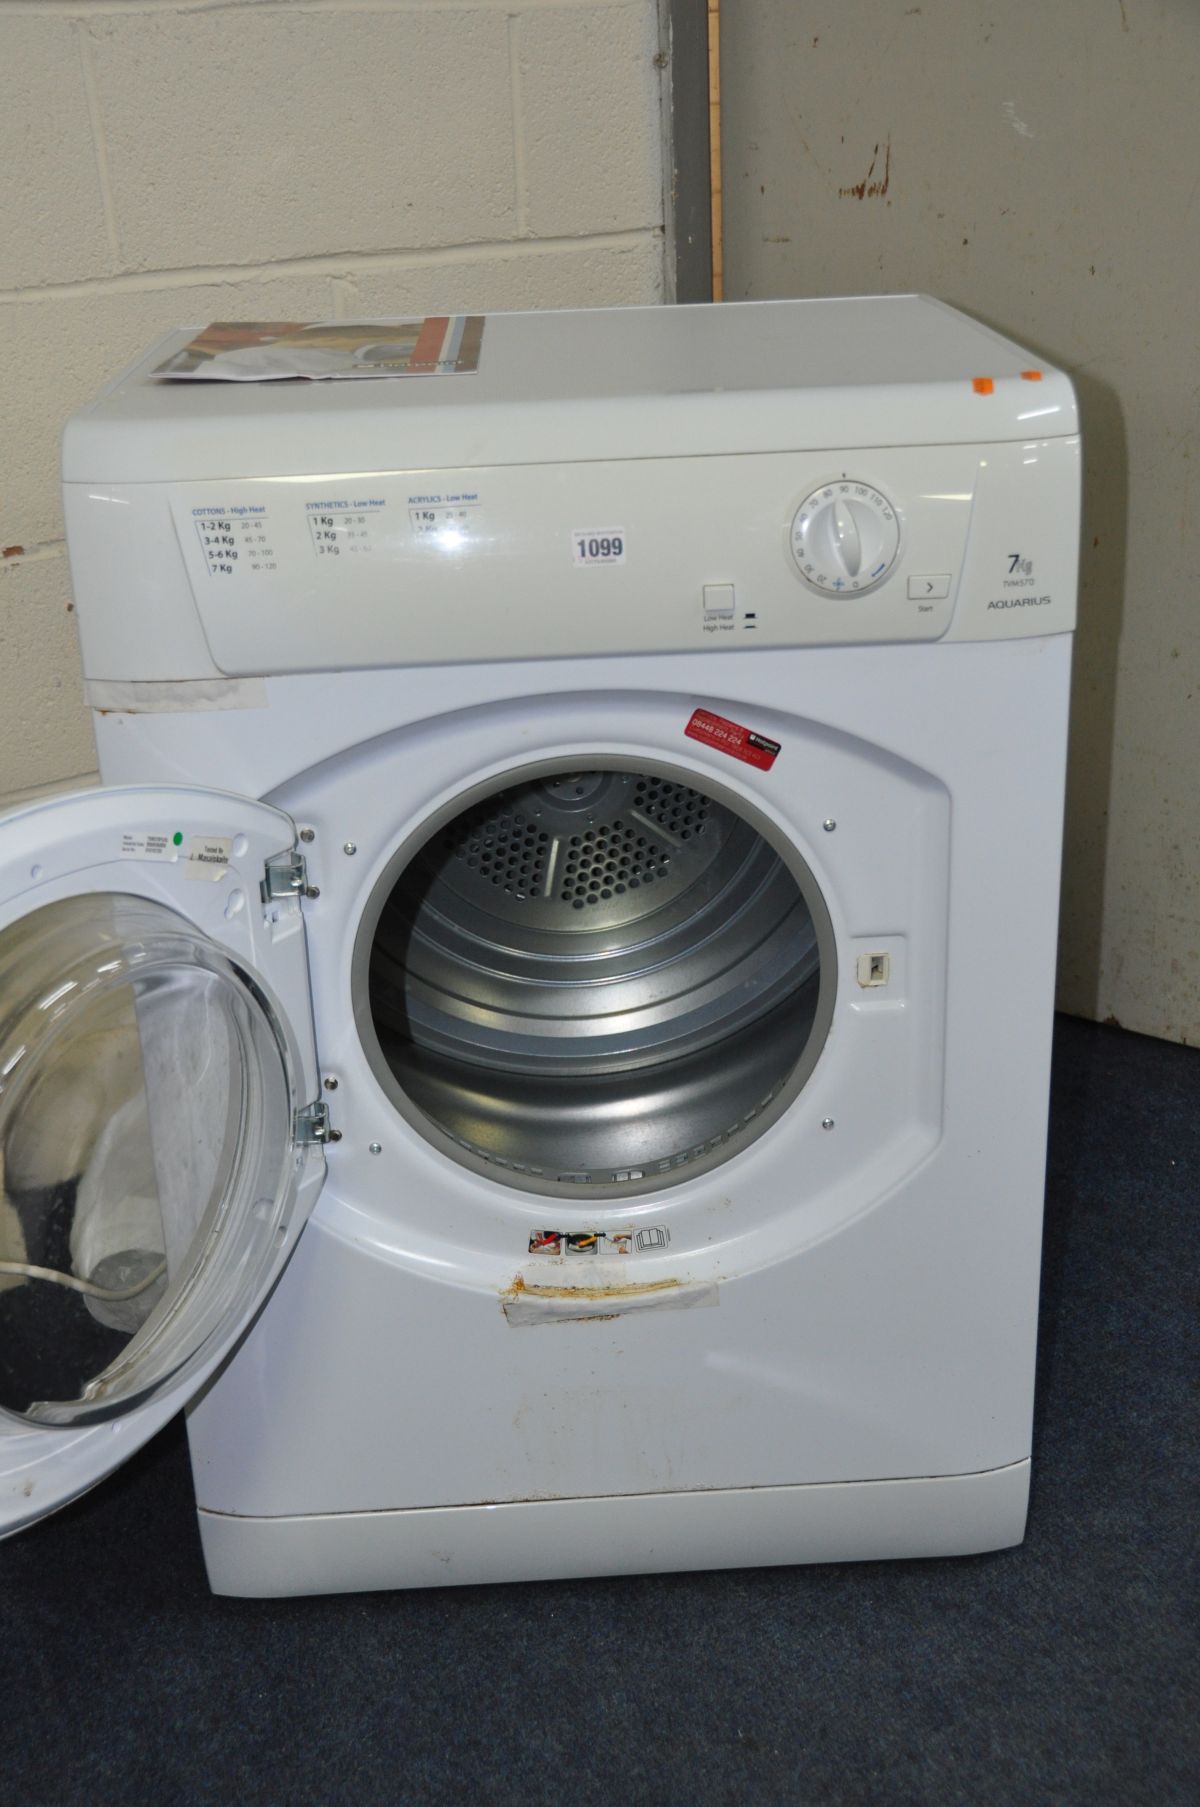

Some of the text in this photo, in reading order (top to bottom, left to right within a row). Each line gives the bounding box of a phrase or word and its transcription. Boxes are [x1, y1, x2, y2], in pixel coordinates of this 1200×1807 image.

[408, 495, 441, 504] ACRYLICS
[192, 506, 226, 516] COTTONS
[231, 506, 247, 515] High
[249, 505, 265, 513] Heat
[305, 501, 348, 510] SYNTHETICS
[320, 516, 334, 527] Kg
[422, 511, 435, 522] Kg
[201, 521, 231, 532] 1-2 Kg
[204, 535, 235, 546] 3-4 Kg
[324, 531, 337, 541] Kg
[327, 544, 340, 555] Kg
[577, 537, 623, 558] 1099
[208, 549, 238, 560] 5-6 Kg
[211, 563, 233, 574] 7 Kg
[987, 595, 1052, 610] AQUARIUS
[713, 728, 728, 739] 224
[727, 735, 742, 745] 224
